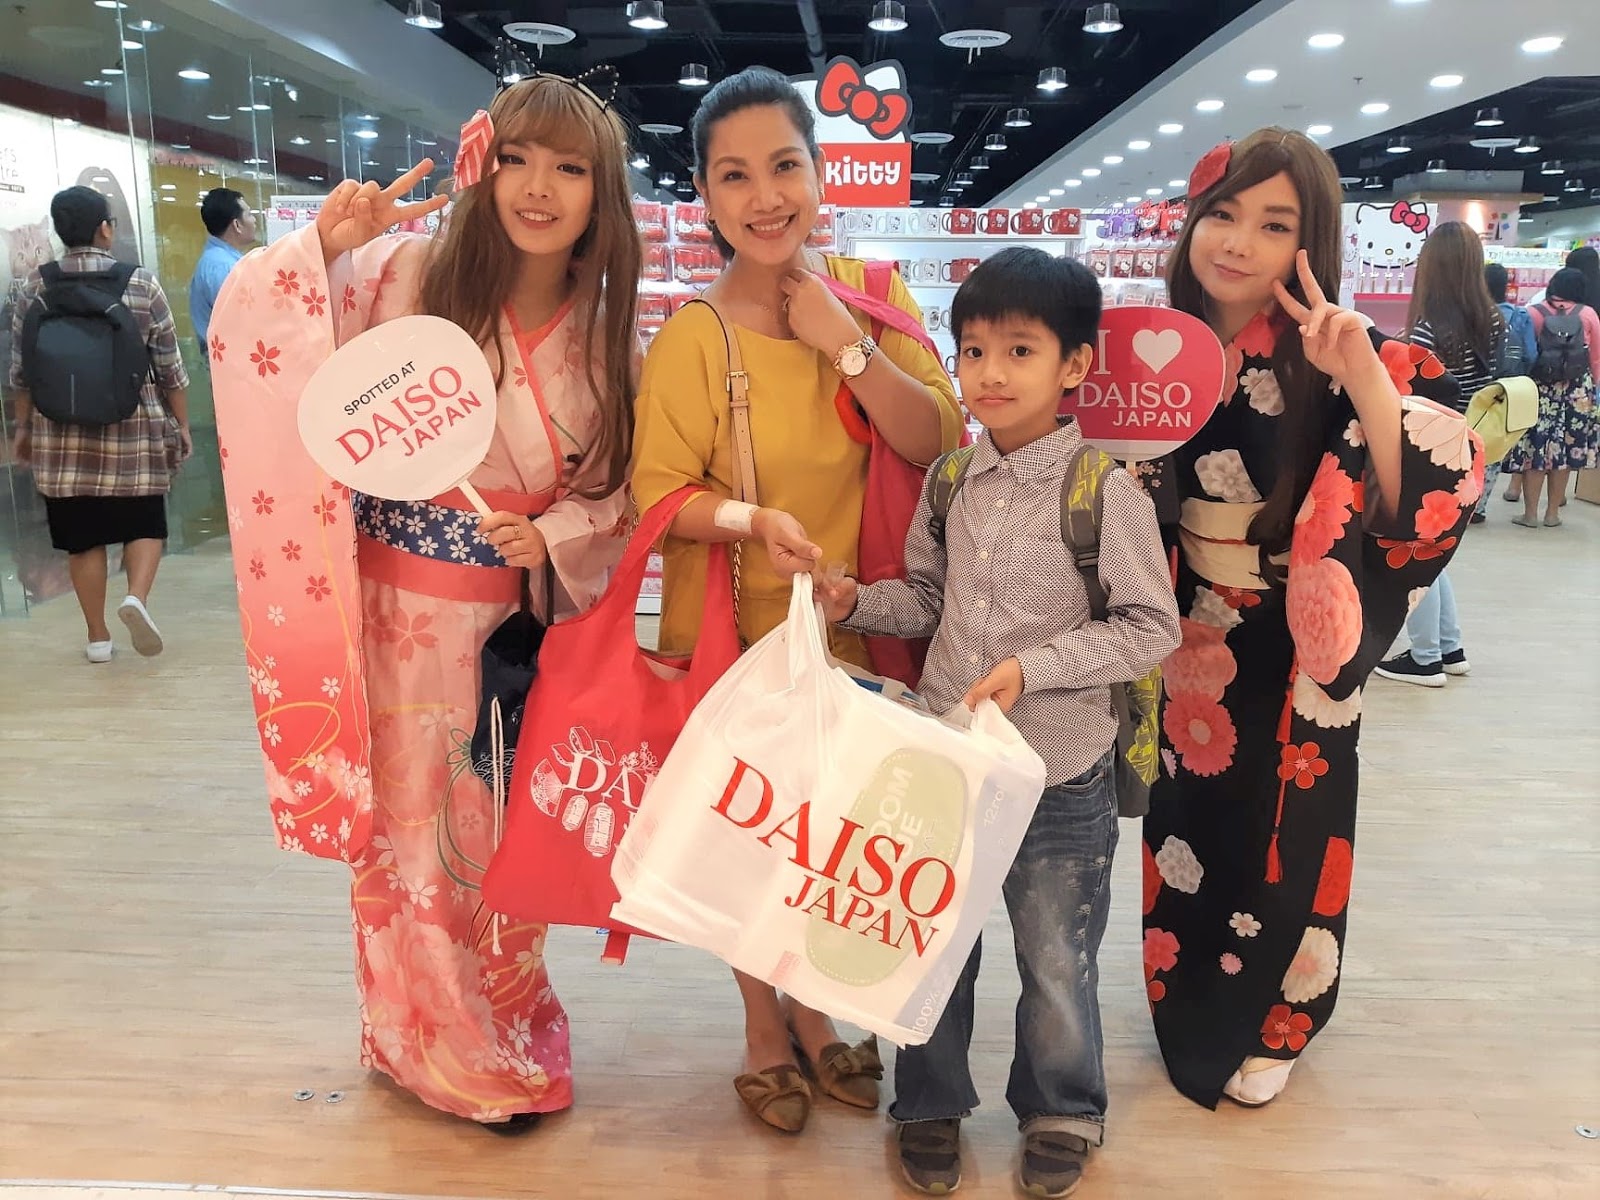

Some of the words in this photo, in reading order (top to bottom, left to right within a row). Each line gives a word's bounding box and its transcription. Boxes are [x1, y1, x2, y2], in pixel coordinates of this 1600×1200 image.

[1094, 329, 1112, 375] I
[335, 366, 462, 465] DAISO
[344, 373, 400, 416] SPOTTED
[401, 361, 416, 378] AT
[1077, 381, 1192, 409] DAISO
[1112, 410, 1192, 428] JAPAN
[402, 390, 482, 457] JAPAN
[710, 756, 956, 918] DAISO
[784, 874, 940, 958] JAPAN
